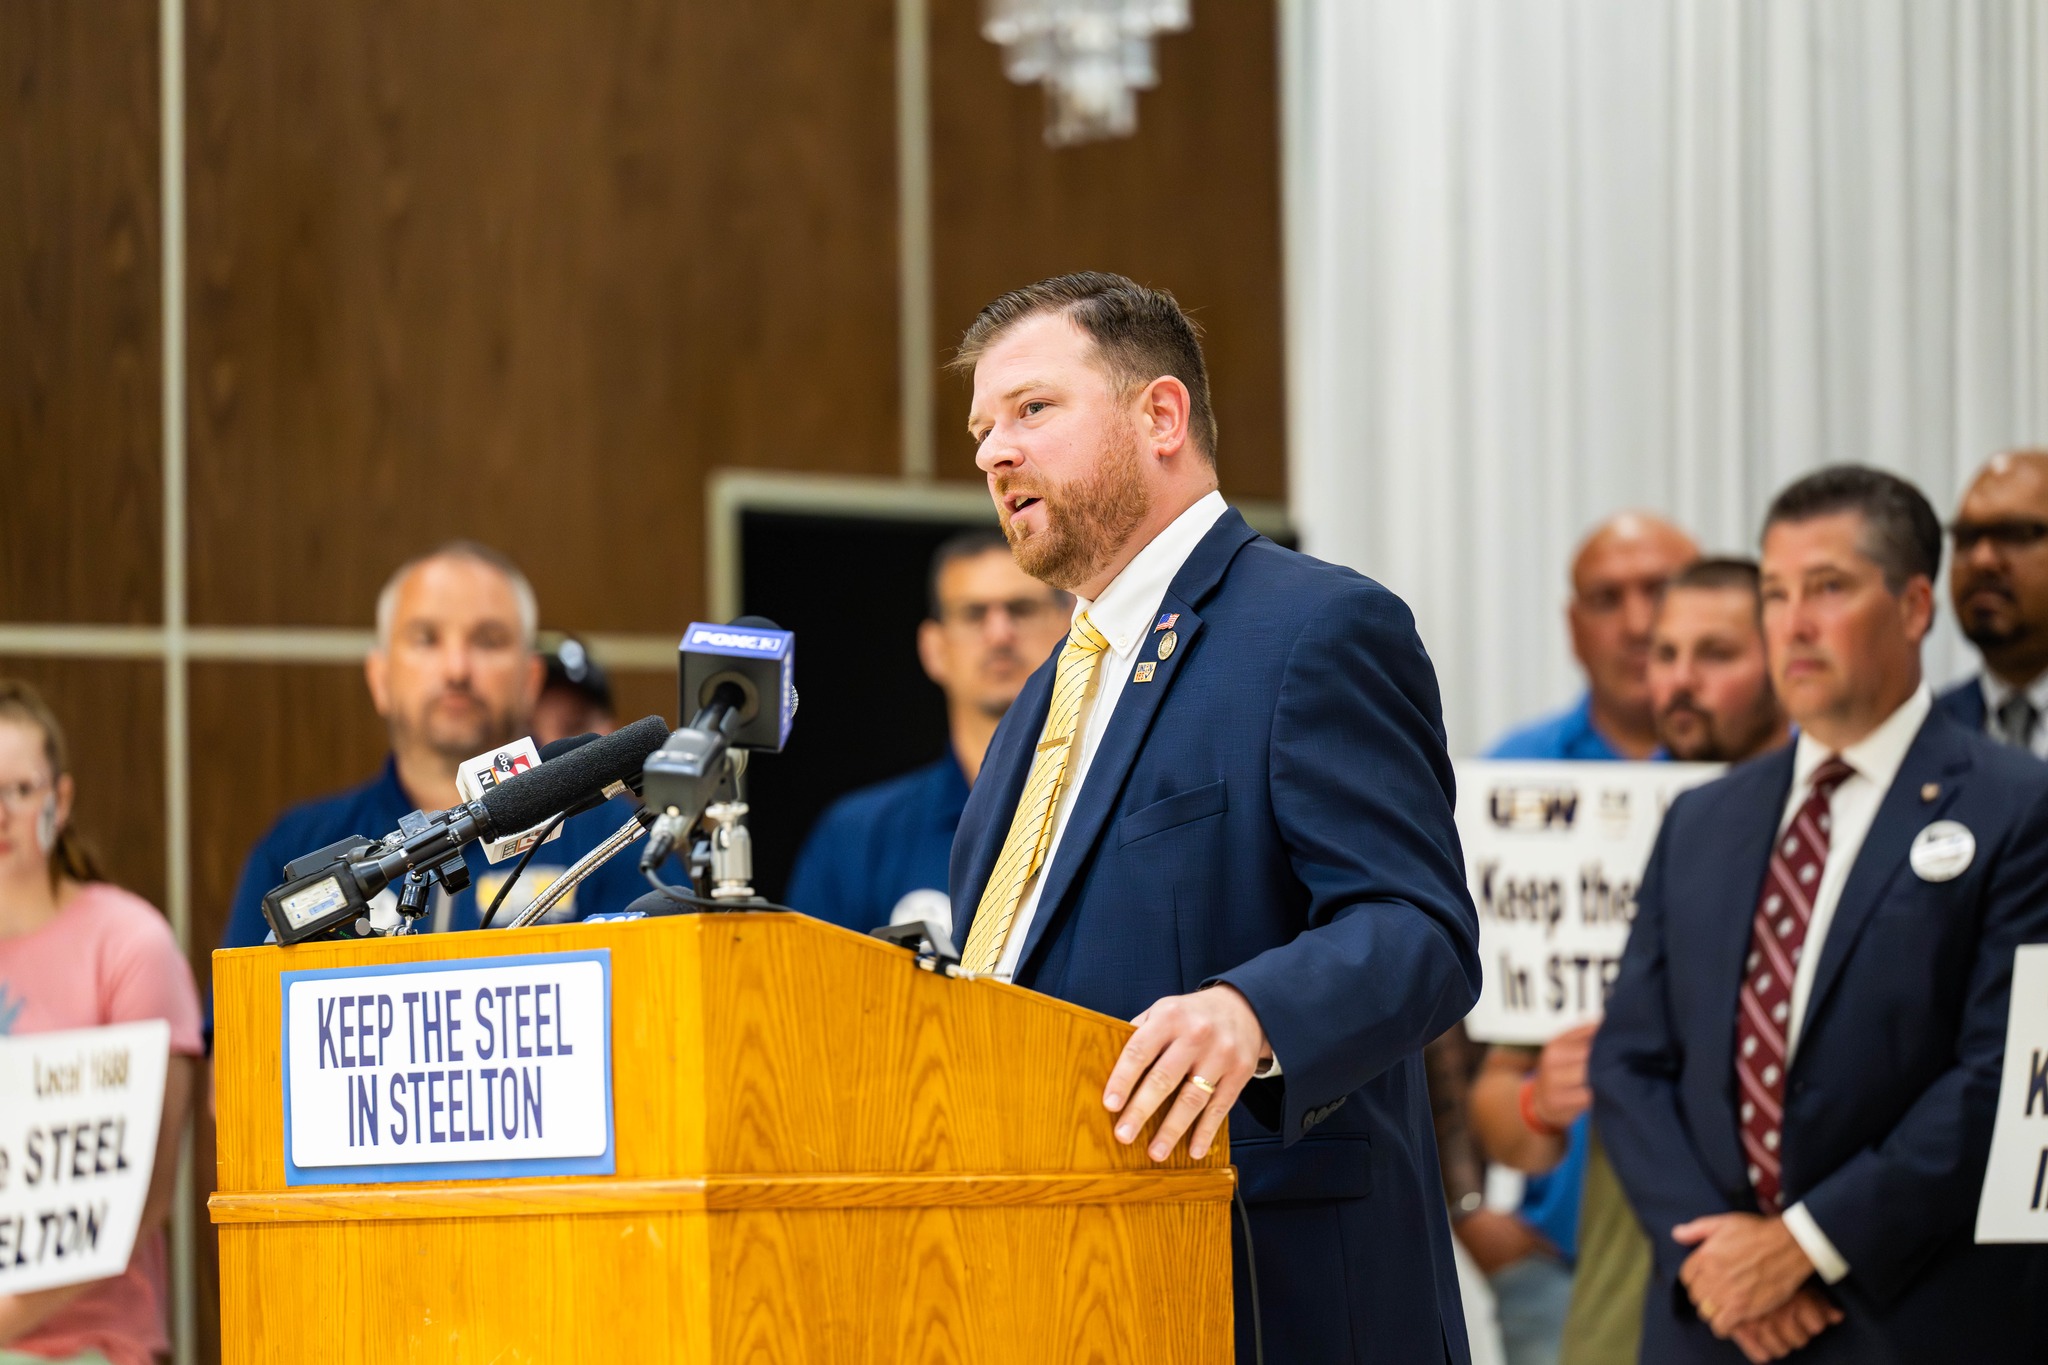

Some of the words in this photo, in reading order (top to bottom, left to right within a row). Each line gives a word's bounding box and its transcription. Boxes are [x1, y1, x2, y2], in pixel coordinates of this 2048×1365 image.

[497, 753, 511, 772] abc
[318, 994, 393, 1069] KEEP
[402, 989, 464, 1064] THE
[475, 983, 573, 1060] STEEL
[348, 1074, 379, 1147] IN
[390, 1066, 543, 1145] STEELTON
[25, 1116, 129, 1185] STEEL
